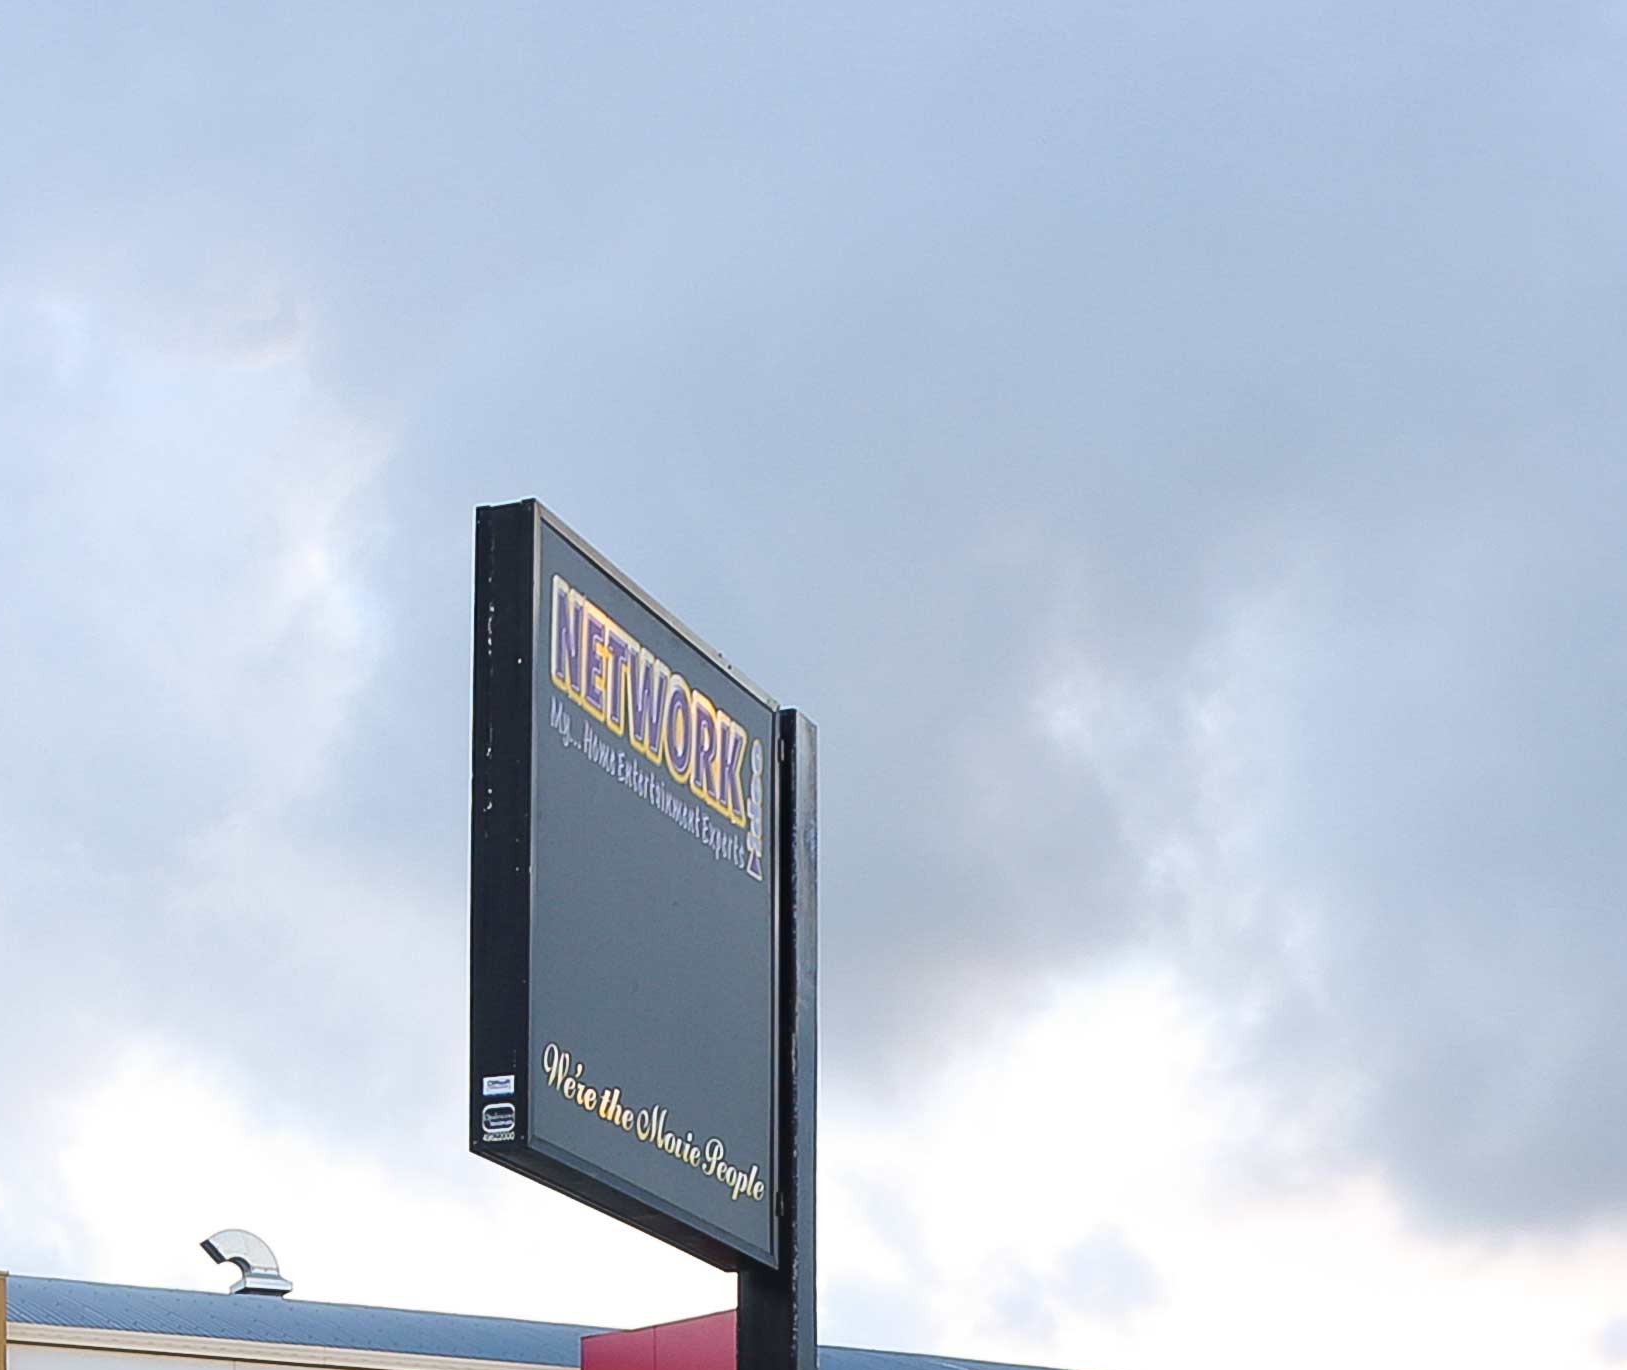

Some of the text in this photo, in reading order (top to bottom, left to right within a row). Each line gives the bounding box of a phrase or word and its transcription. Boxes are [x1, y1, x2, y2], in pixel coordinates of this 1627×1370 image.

[551, 574, 748, 828] NETWORK
[583, 719, 617, 777] Home
[617, 752, 701, 838] Entertainment
[701, 815, 747, 870] Experts
[542, 1042, 766, 1202] We're the Movie People
